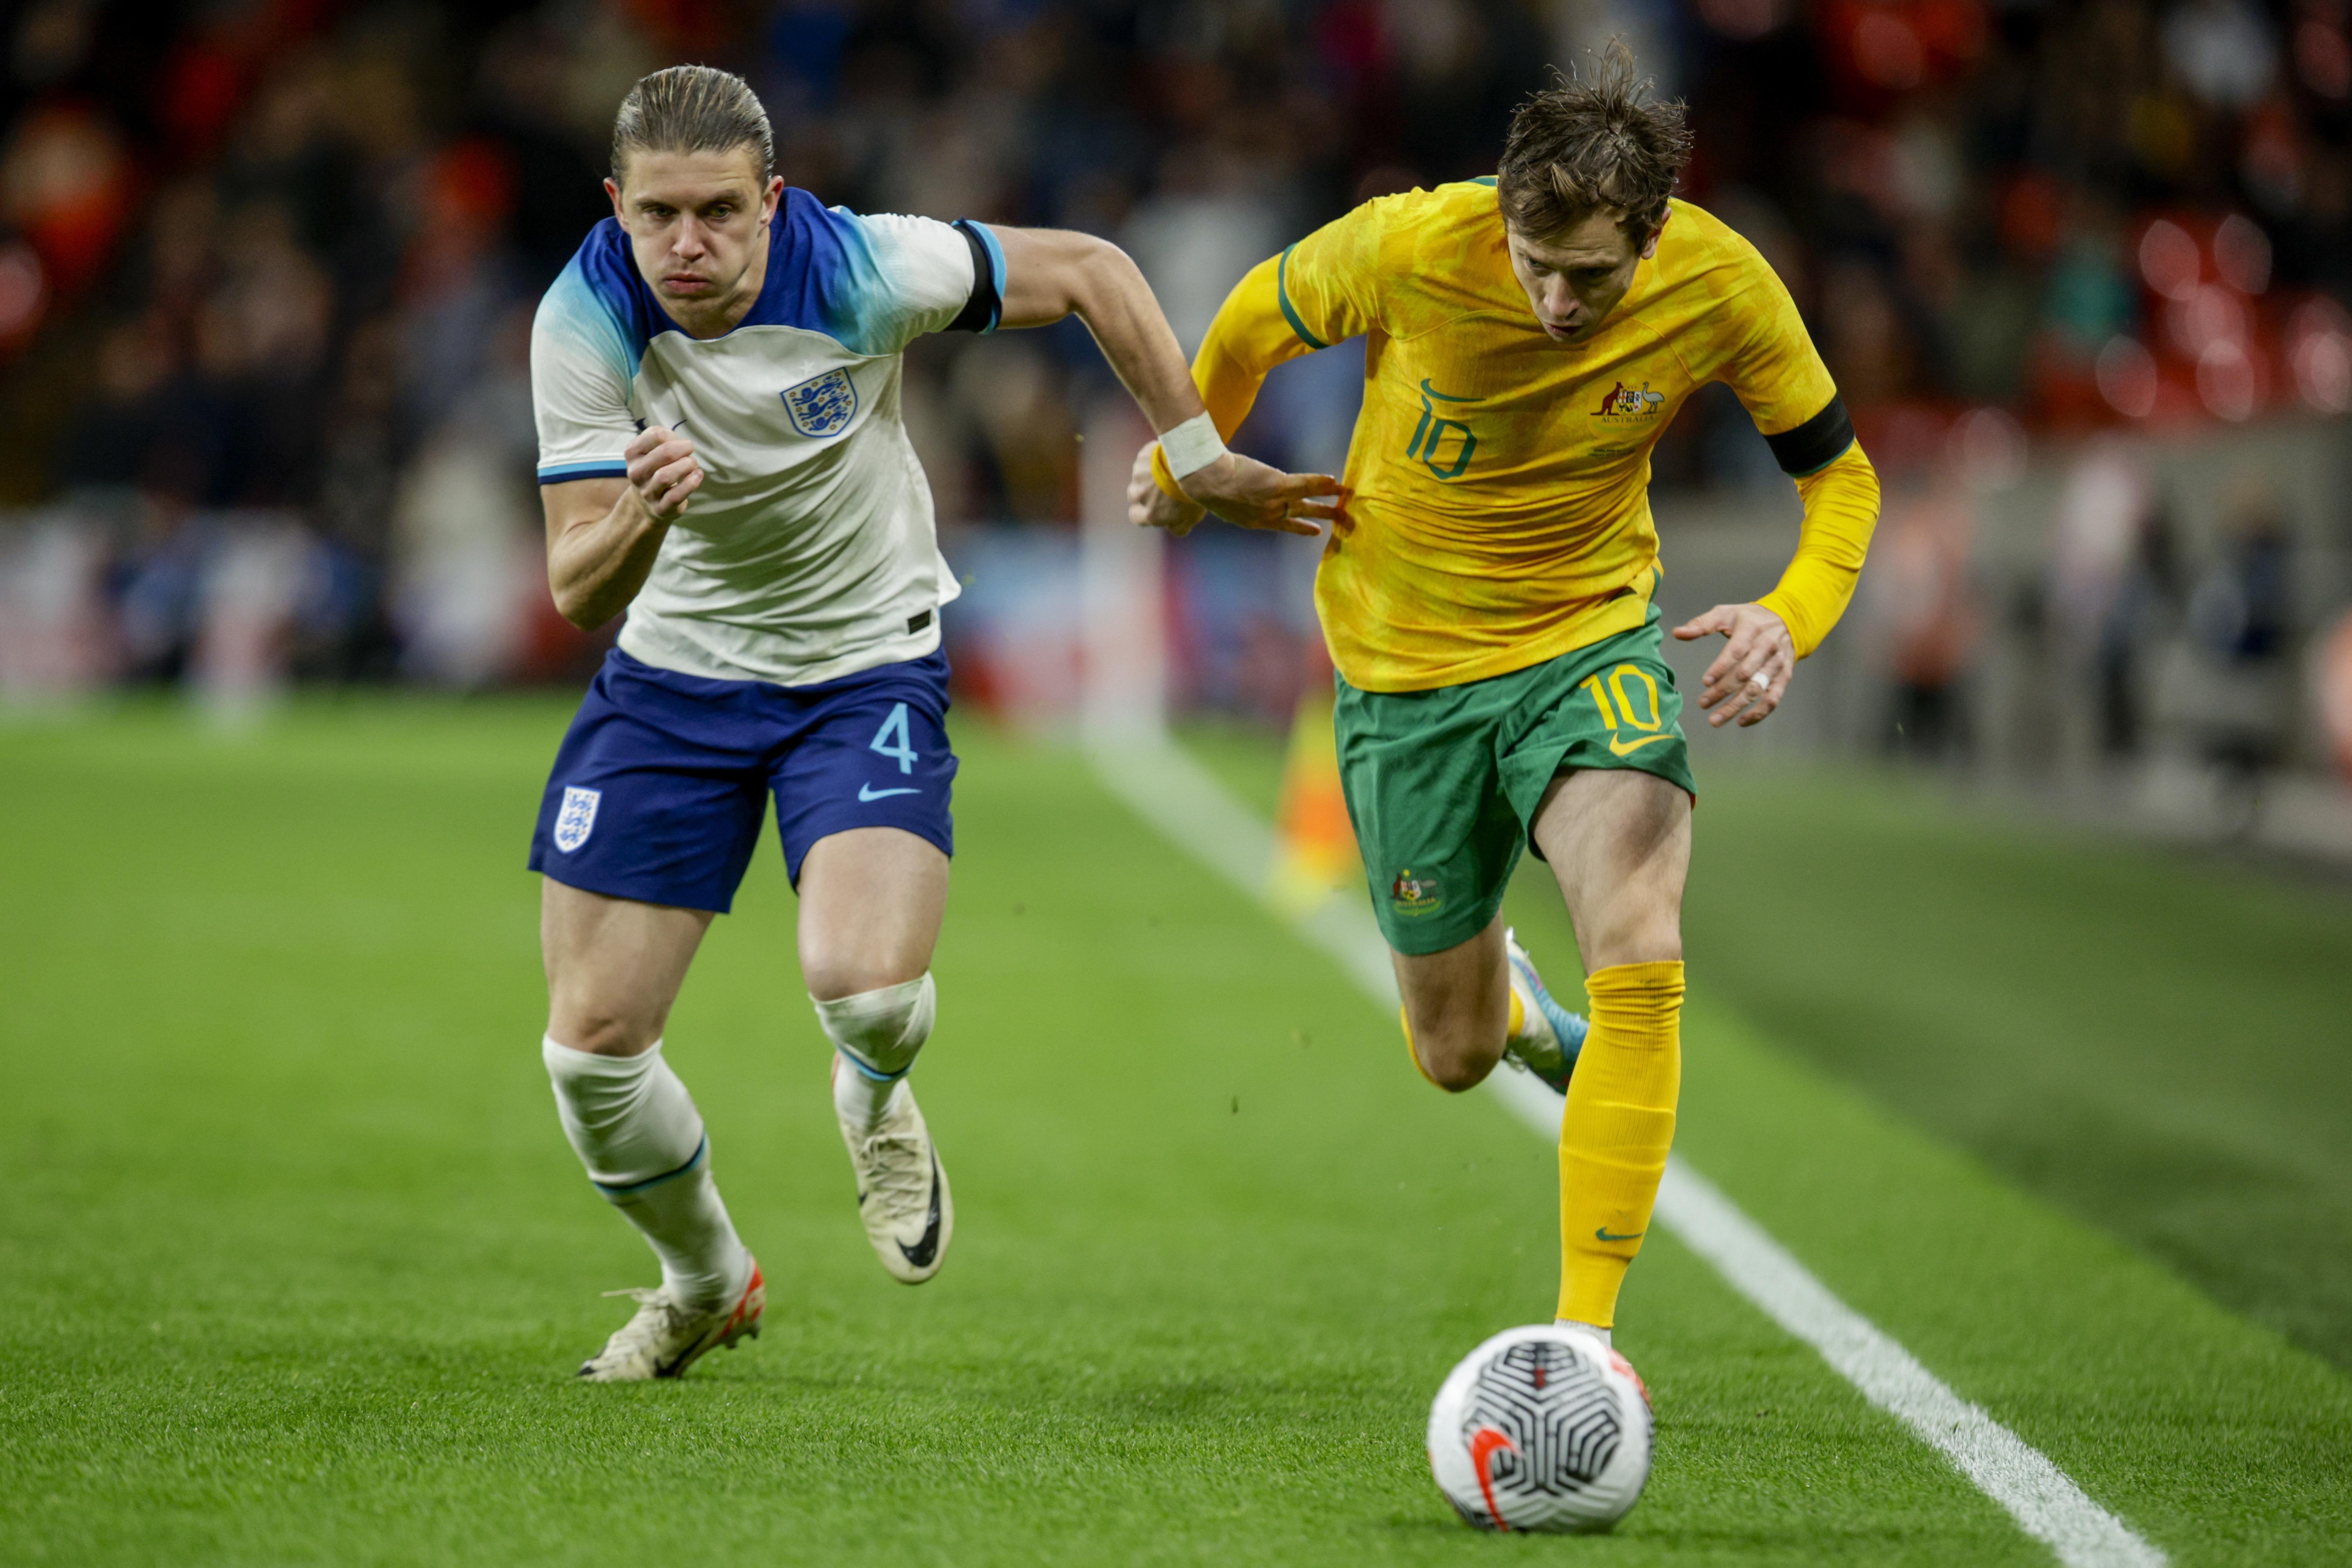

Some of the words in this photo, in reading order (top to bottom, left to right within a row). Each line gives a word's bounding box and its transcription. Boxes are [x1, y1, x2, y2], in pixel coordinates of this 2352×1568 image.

[1406, 394, 1478, 480] 10
[1579, 664, 1662, 732] 10
[869, 702, 918, 775] 4
